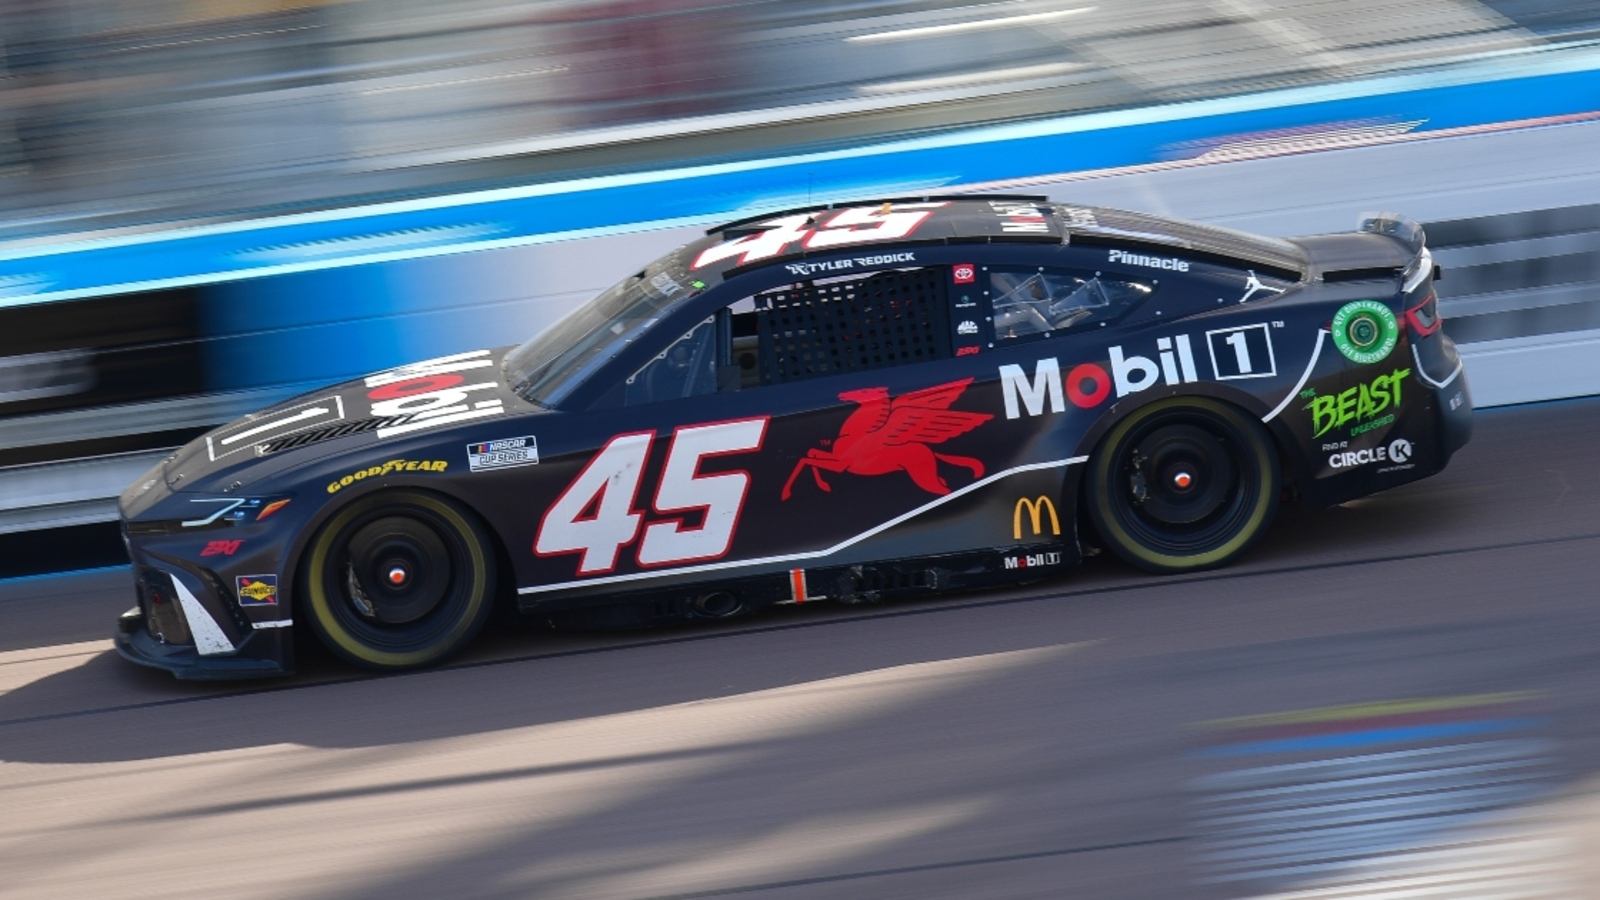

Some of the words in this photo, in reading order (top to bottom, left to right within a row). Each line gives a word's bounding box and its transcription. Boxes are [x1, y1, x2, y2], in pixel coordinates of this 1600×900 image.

[690, 201, 952, 271] 45
[809, 259, 853, 272] TYLER
[853, 252, 916, 266] REDDICK
[1108, 249, 1190, 273] Pinnacle
[999, 334, 1198, 420] Mobil
[1302, 368, 1412, 439] BEAST
[489, 440, 527, 451] NASCAR
[480, 453, 497, 465] CUP
[497, 450, 528, 462] SERIES
[1328, 446, 1387, 469] CIRCLE
[327, 459, 448, 494] GOODYEAR
[534, 415, 772, 576] 45
[1003, 554, 1044, 570] Mobil
[241, 586, 278, 596] SUNOCO
